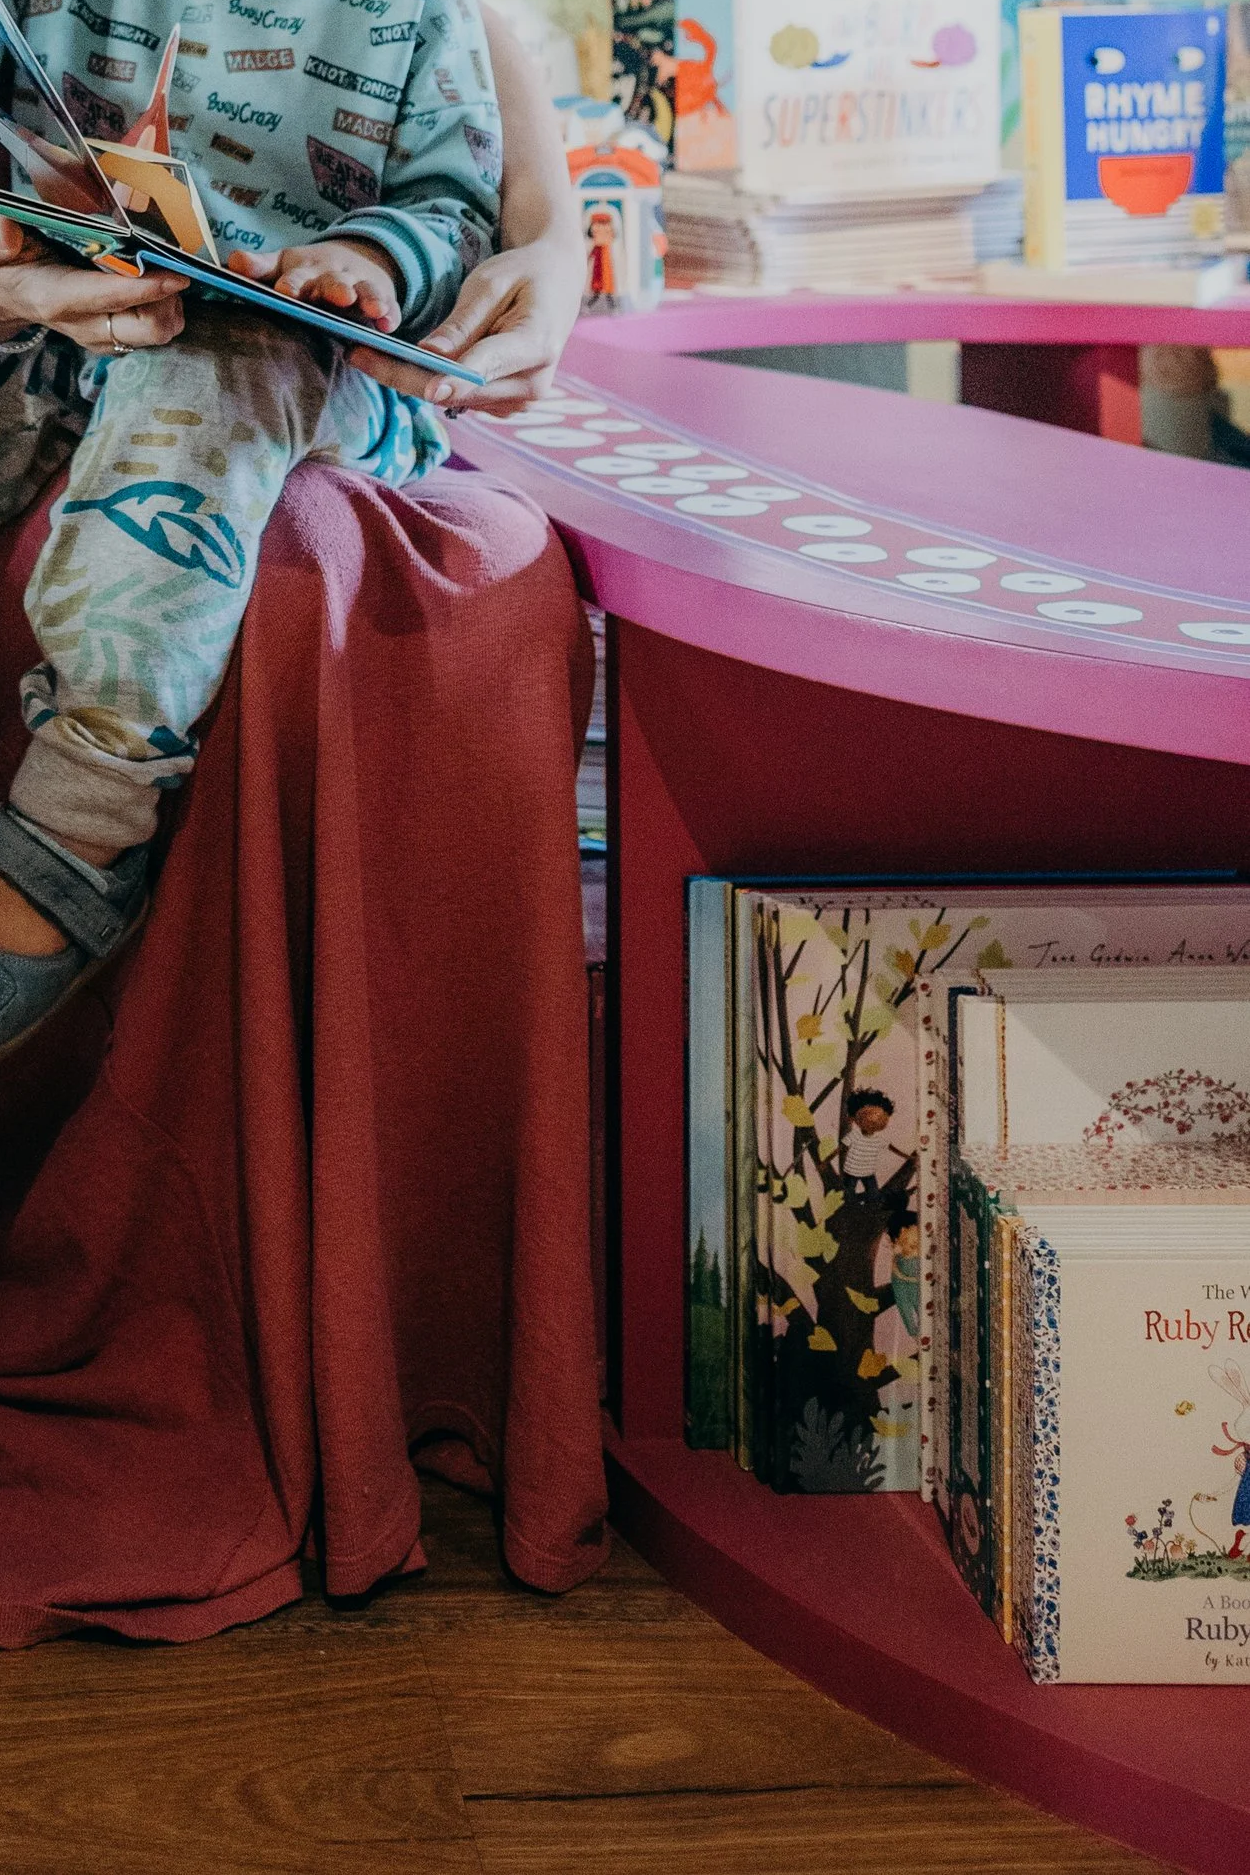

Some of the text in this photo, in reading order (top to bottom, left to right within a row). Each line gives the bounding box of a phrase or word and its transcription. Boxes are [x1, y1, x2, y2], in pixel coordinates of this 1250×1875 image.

[370, 24, 411, 44] KNOT
[225, 49, 293, 72] MADGE
[305, 57, 348, 85] KNOT
[1084, 82, 1206, 118] RHYME
[1086, 119, 1205, 153] HUNGRY
[1167, 937, 1215, 964] Anna
[1202, 1284, 1235, 1300] The
[1144, 1308, 1220, 1350] Ruby
[1202, 1596, 1215, 1609] A
[1185, 1615, 1250, 1647] Ruby
[1205, 1651, 1218, 1672] by
